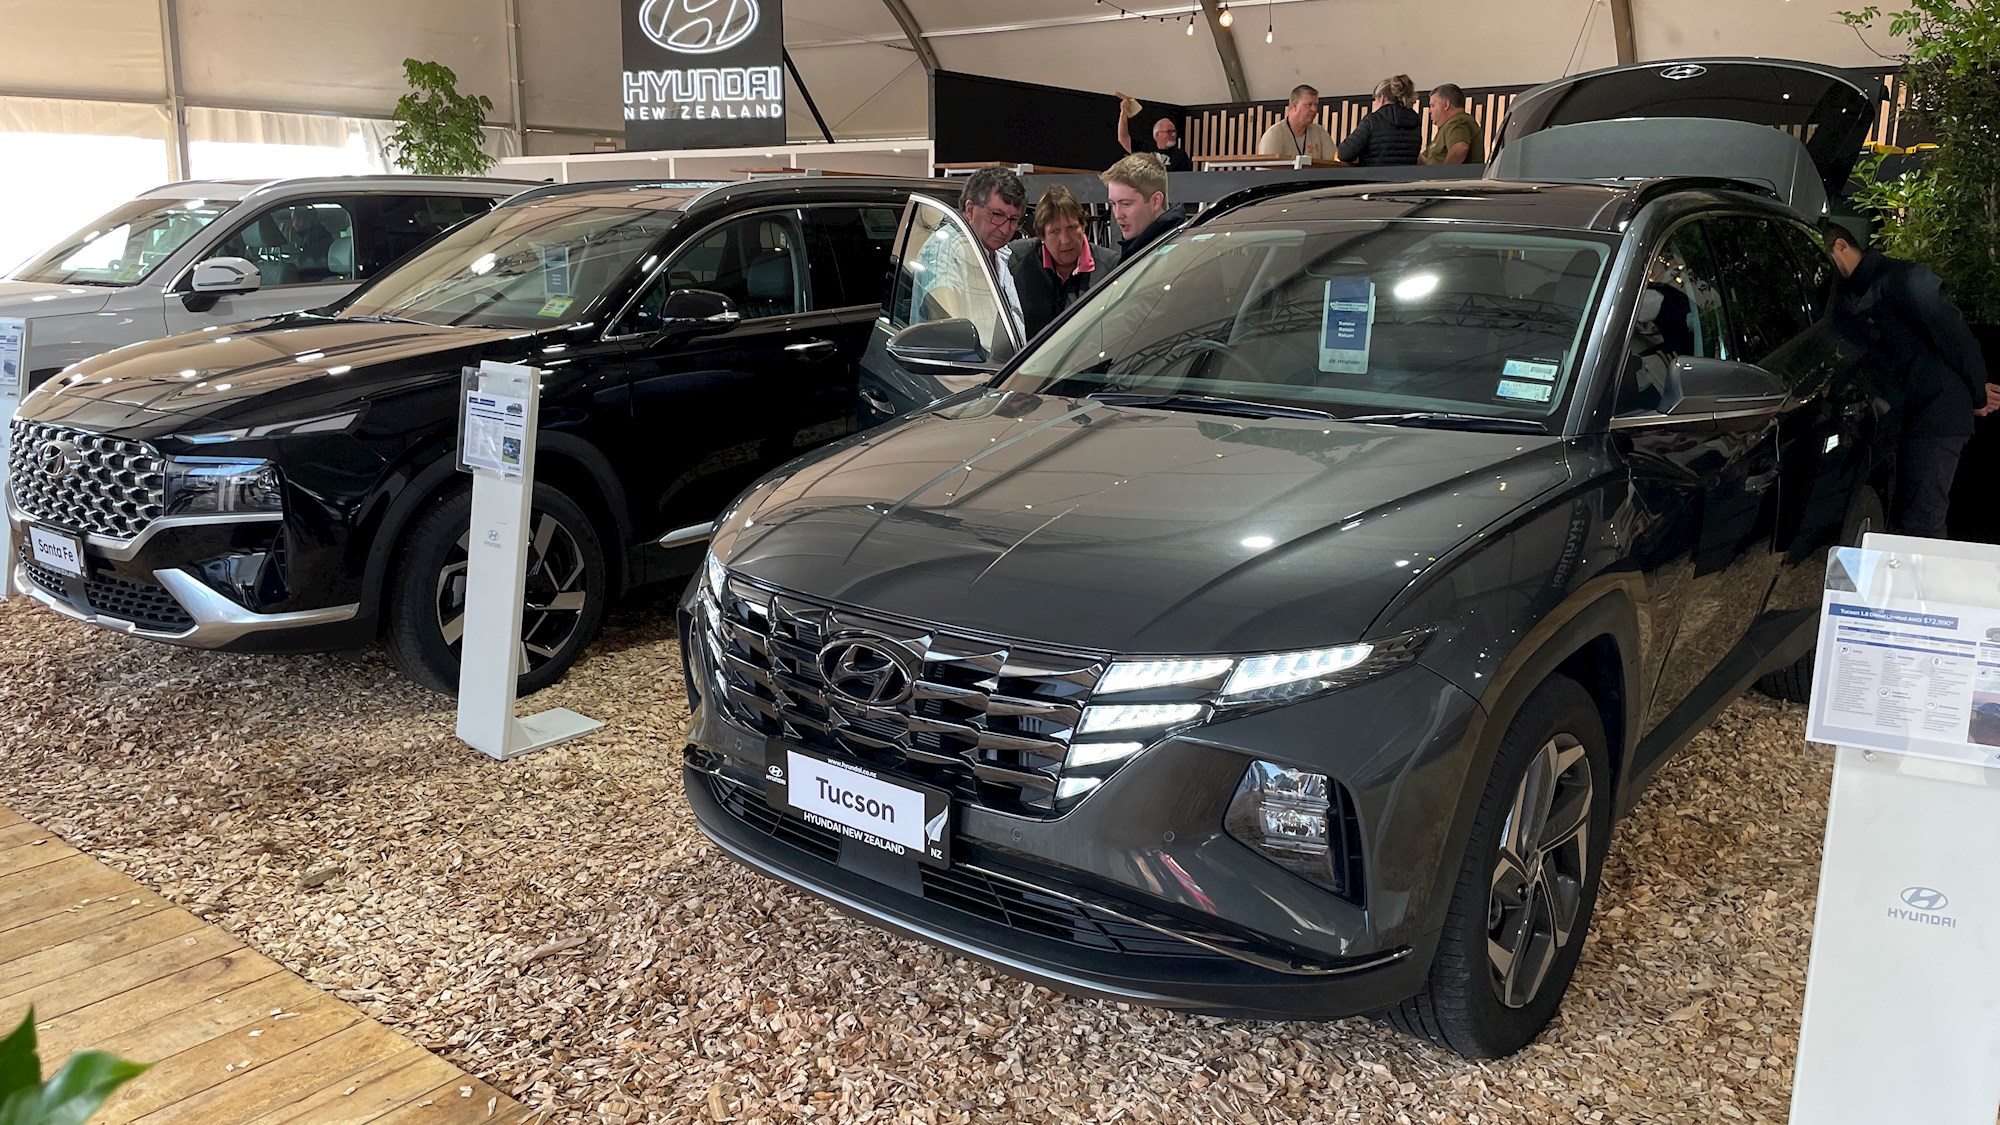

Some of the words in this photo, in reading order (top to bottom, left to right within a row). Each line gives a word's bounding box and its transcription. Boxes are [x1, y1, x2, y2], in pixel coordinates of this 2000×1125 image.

[622, 66, 781, 104] HYUNDAI
[623, 106, 666, 120] NEW
[681, 103, 783, 119] ZEALAND
[37, 539, 62, 559] Santa
[62, 546, 74, 562] Fe
[1840, 608, 1860, 616] Tucson
[1886, 613, 1909, 622] Limited
[765, 774, 787, 785] HYUNDAI
[815, 776, 895, 824] Tucson
[803, 811, 842, 834] HYUNDAI
[842, 825, 864, 841] NEW
[863, 833, 905, 855] ZEALAND
[930, 847, 943, 859] NZ
[1887, 907, 1957, 928] HYUNDAI
